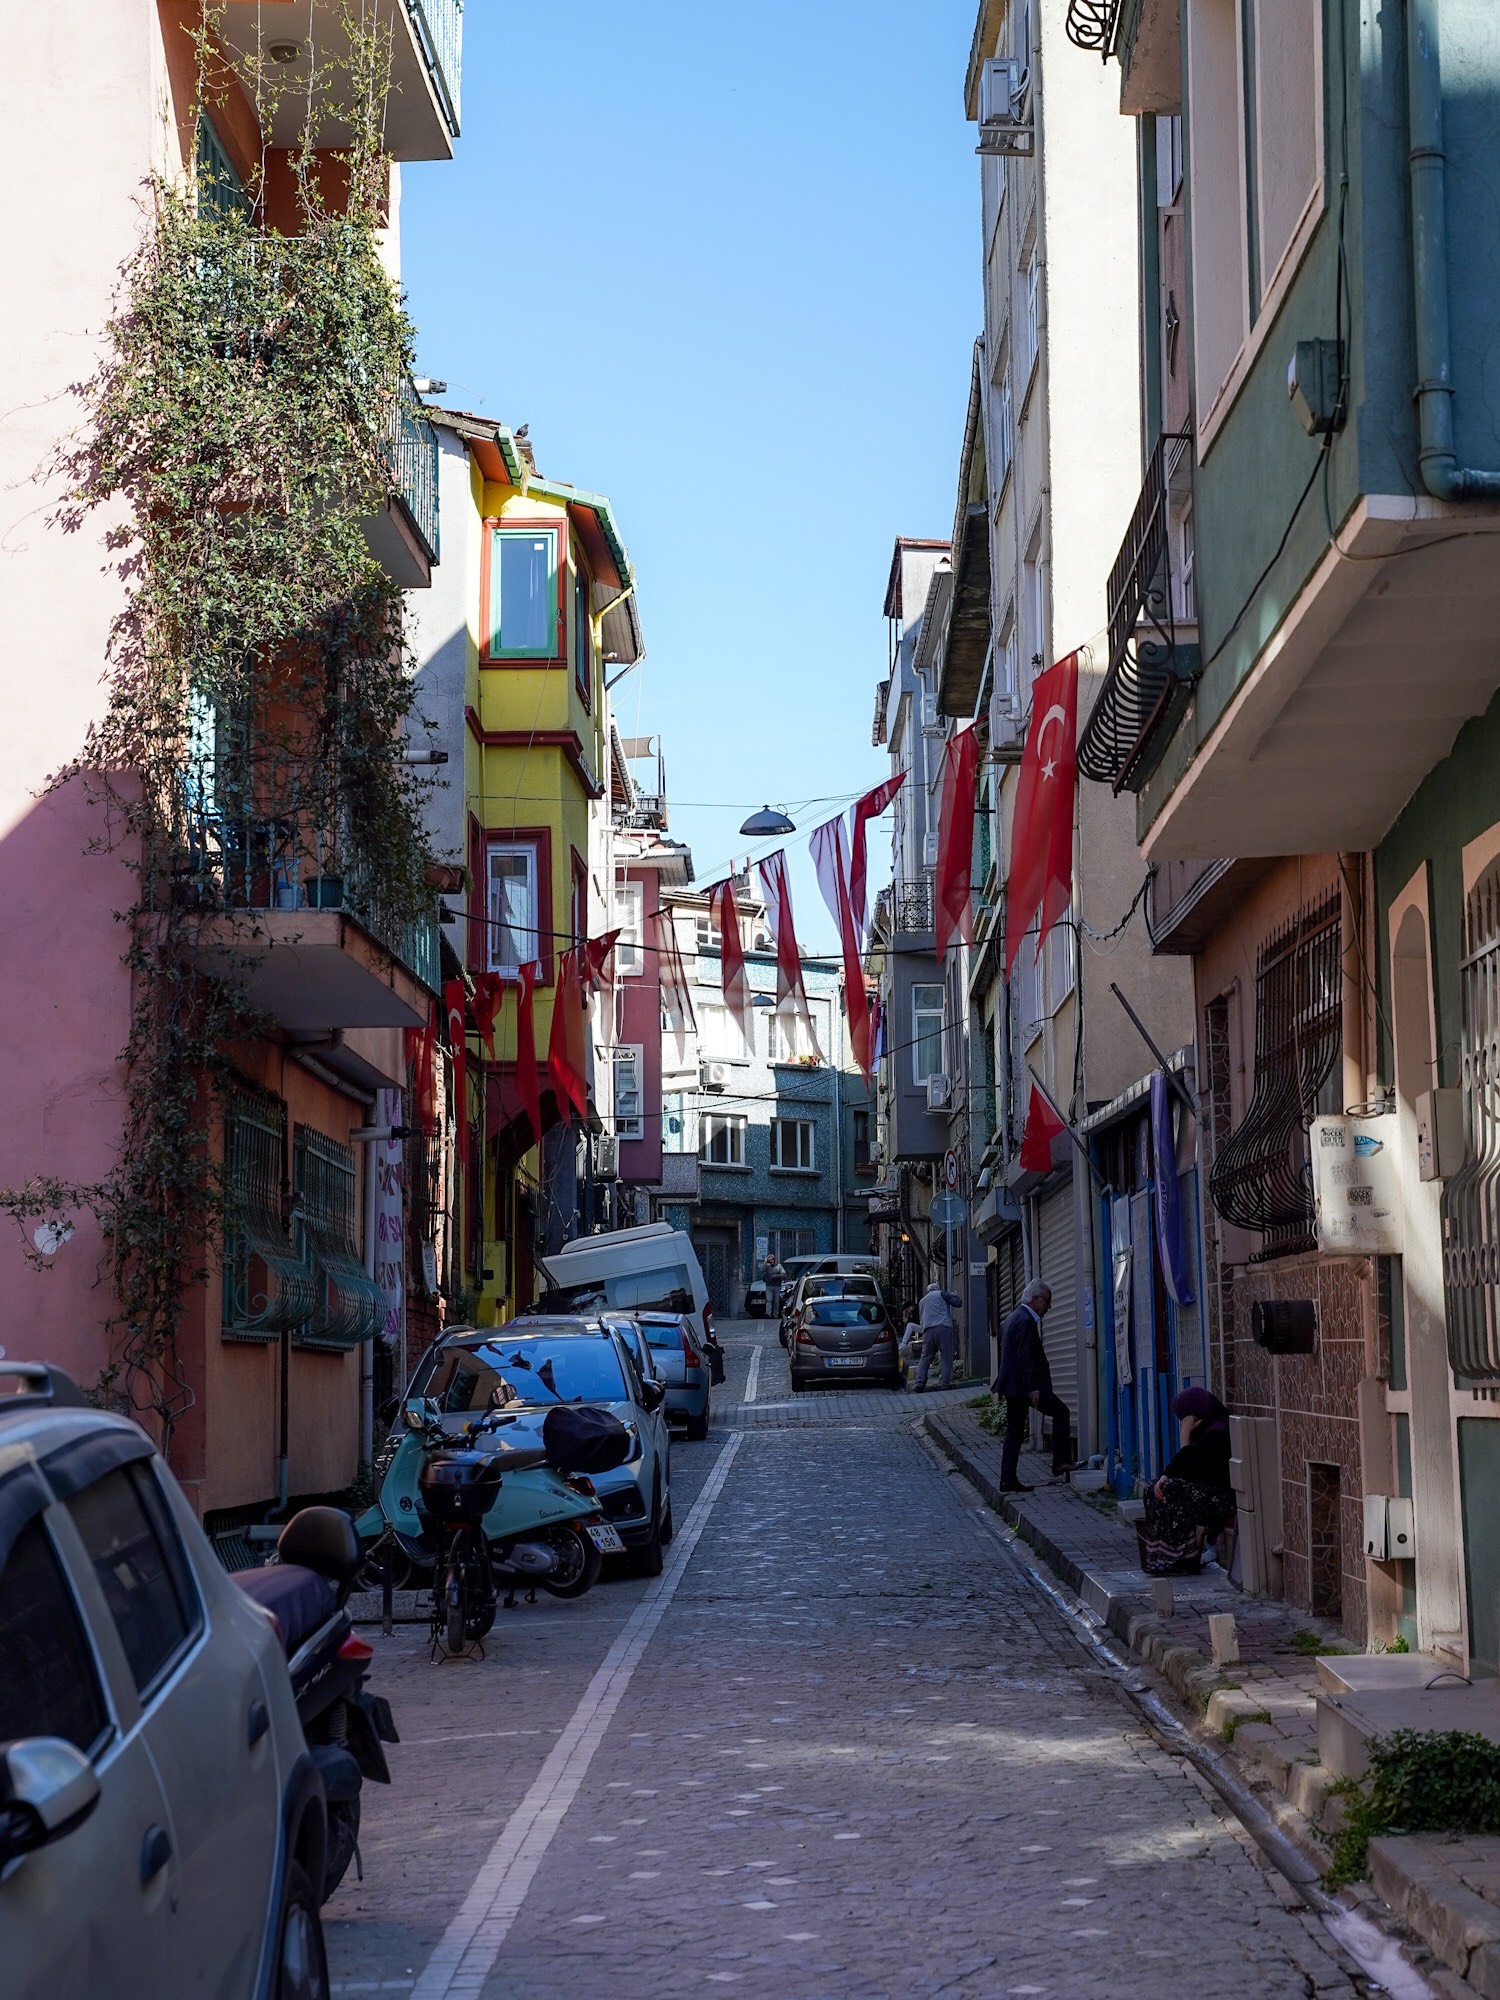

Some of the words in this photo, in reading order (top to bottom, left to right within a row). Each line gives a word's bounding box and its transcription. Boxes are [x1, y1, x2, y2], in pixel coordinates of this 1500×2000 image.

[590, 1528, 601, 1537] 48
[603, 1526, 615, 1536] VE
[601, 1537, 616, 1547] 150
